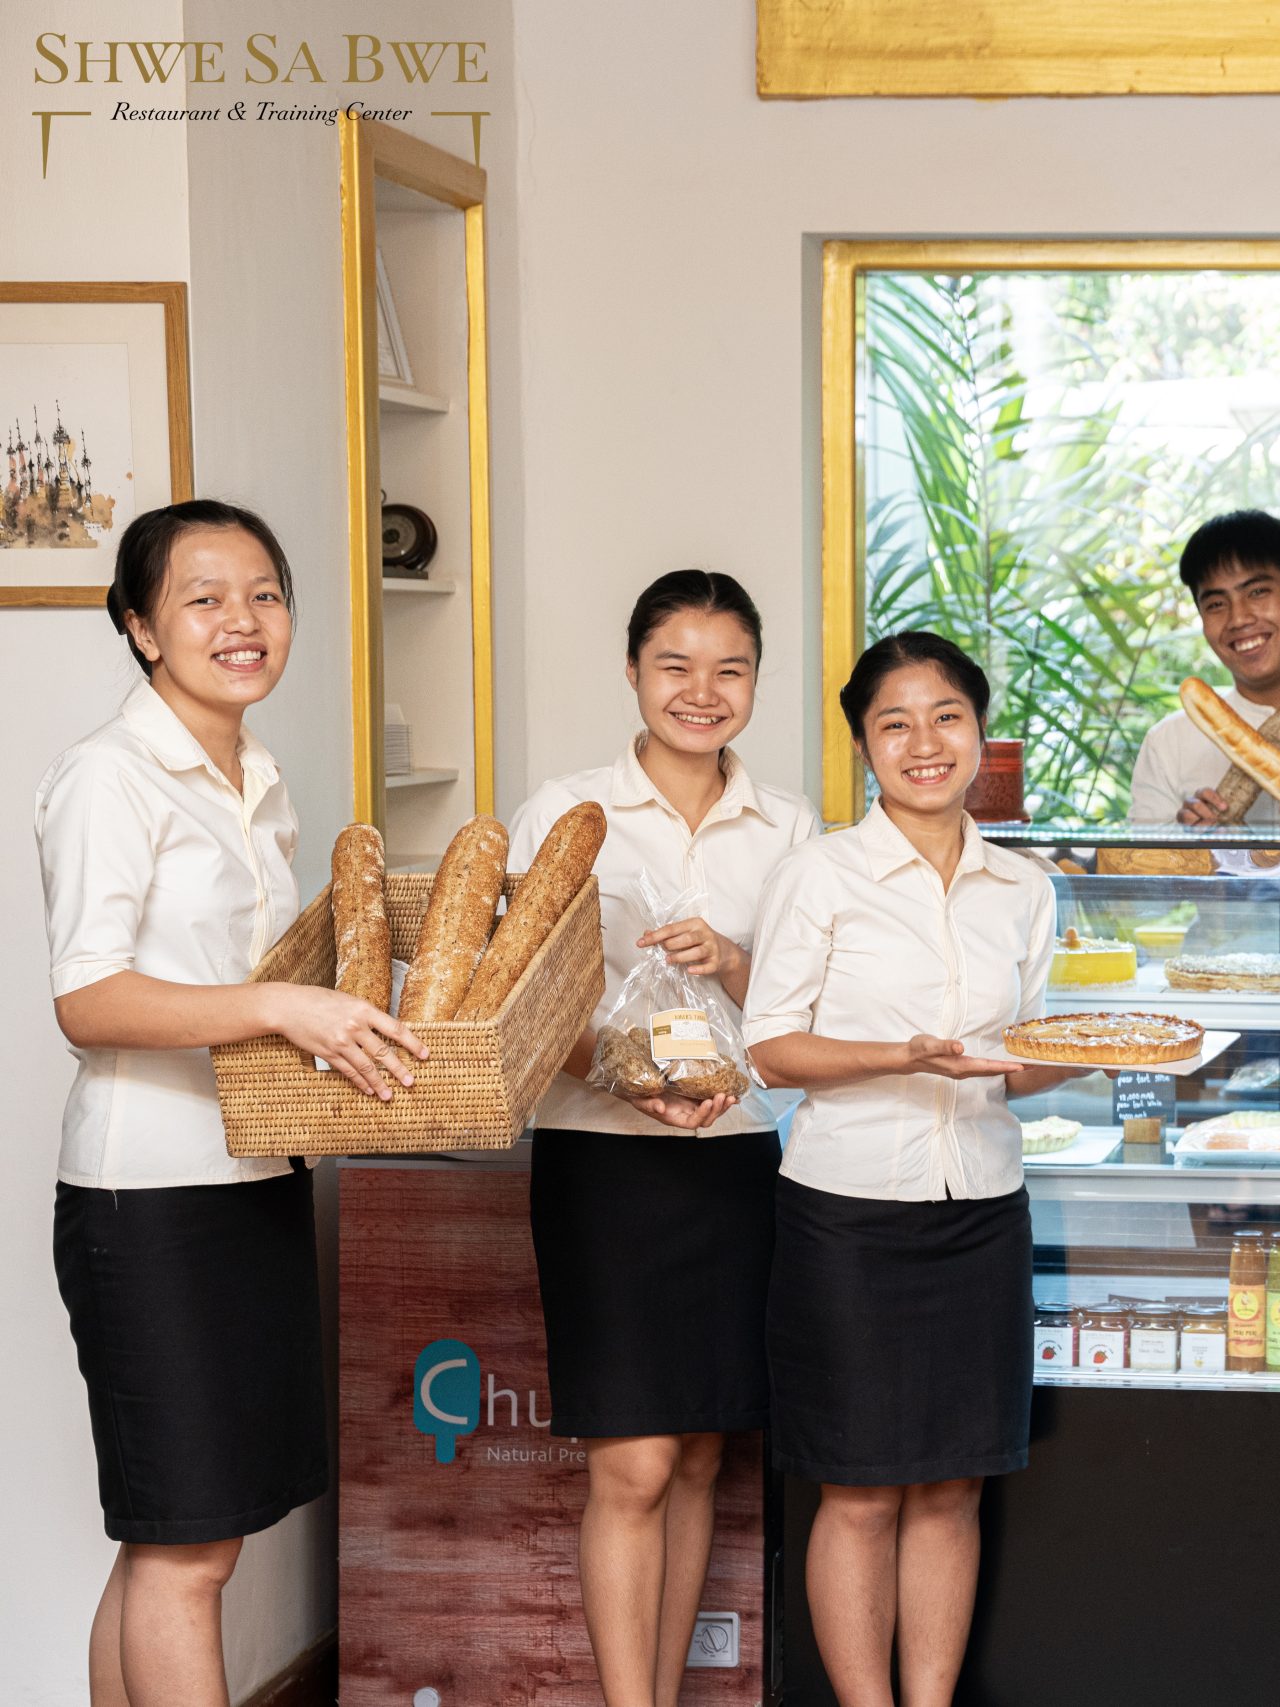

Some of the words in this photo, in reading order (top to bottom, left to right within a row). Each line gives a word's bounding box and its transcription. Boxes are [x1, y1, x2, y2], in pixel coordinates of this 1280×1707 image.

[421, 1358, 577, 1444] Chu
[487, 1447, 552, 1463] Natural
[559, 1448, 587, 1463] Pre
